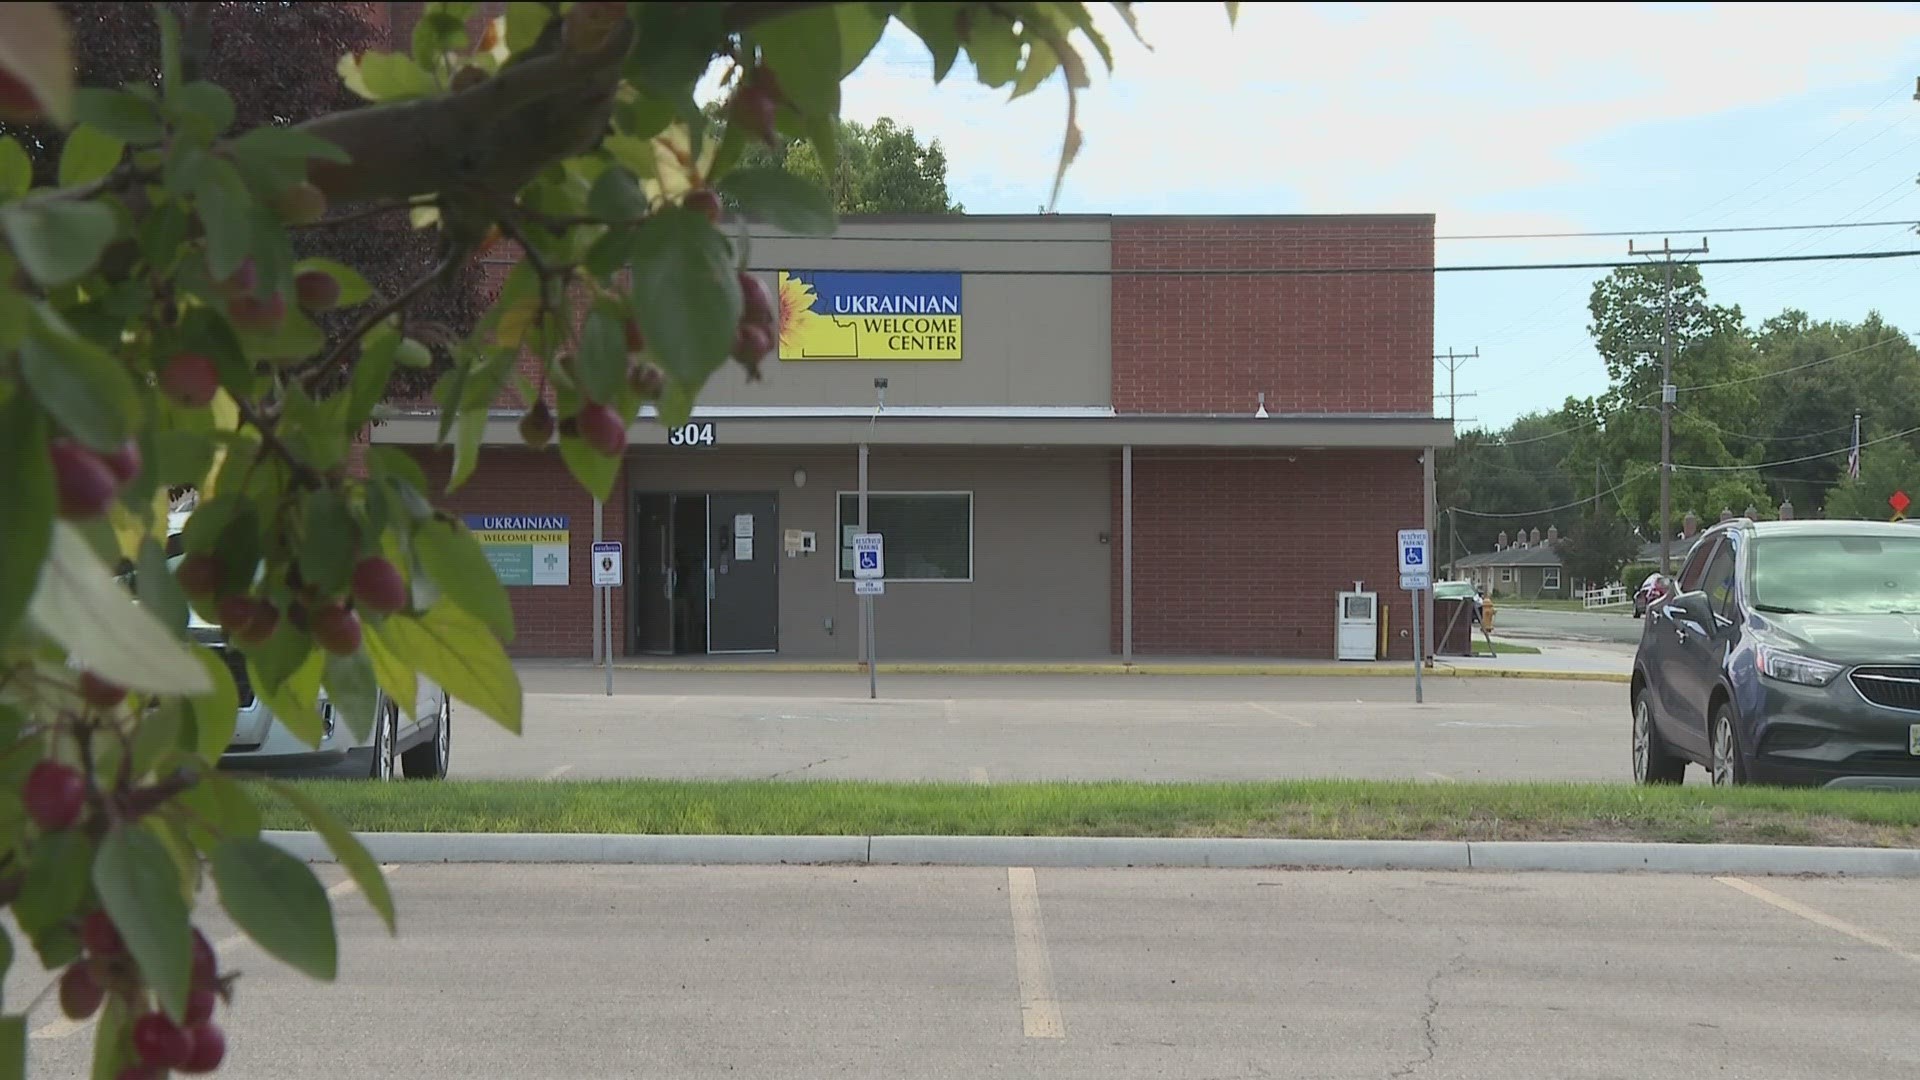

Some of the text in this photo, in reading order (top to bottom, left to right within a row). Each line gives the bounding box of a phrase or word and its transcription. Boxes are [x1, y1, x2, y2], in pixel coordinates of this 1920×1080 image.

[835, 295, 958, 313] UKRAINIAN
[864, 318, 957, 333] WELCOME
[888, 335, 957, 351] CENTER
[670, 423, 714, 445] 304
[483, 517, 563, 529] UKRAINIAN
[483, 533, 562, 542] WELCOME CENTER
